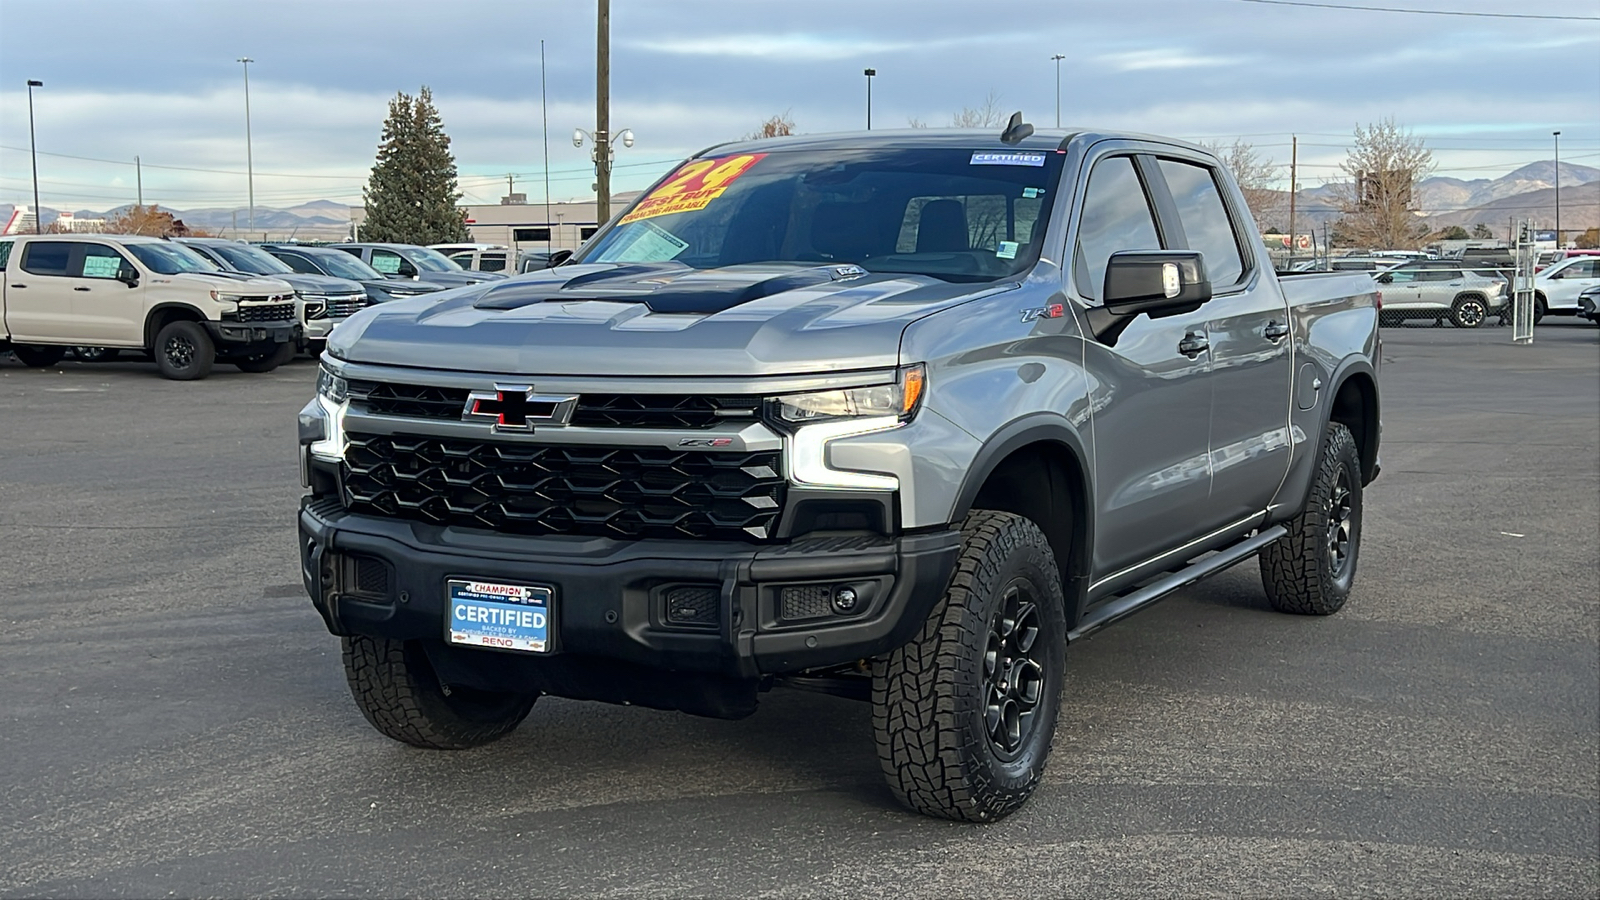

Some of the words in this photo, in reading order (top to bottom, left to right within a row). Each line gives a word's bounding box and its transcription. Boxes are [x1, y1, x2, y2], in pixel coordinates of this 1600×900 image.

[974, 154, 1042, 162] CERTIFIED
[649, 155, 755, 199] 24
[637, 193, 682, 211] BEST
[681, 188, 721, 200] BUY
[661, 199, 707, 214] AVAILABLE
[1019, 303, 1064, 323] ZR2
[474, 584, 522, 596] CHAMPION
[454, 604, 546, 629] CERTIFIED
[481, 625, 507, 633] BACKED
[482, 637, 513, 647] RENO
